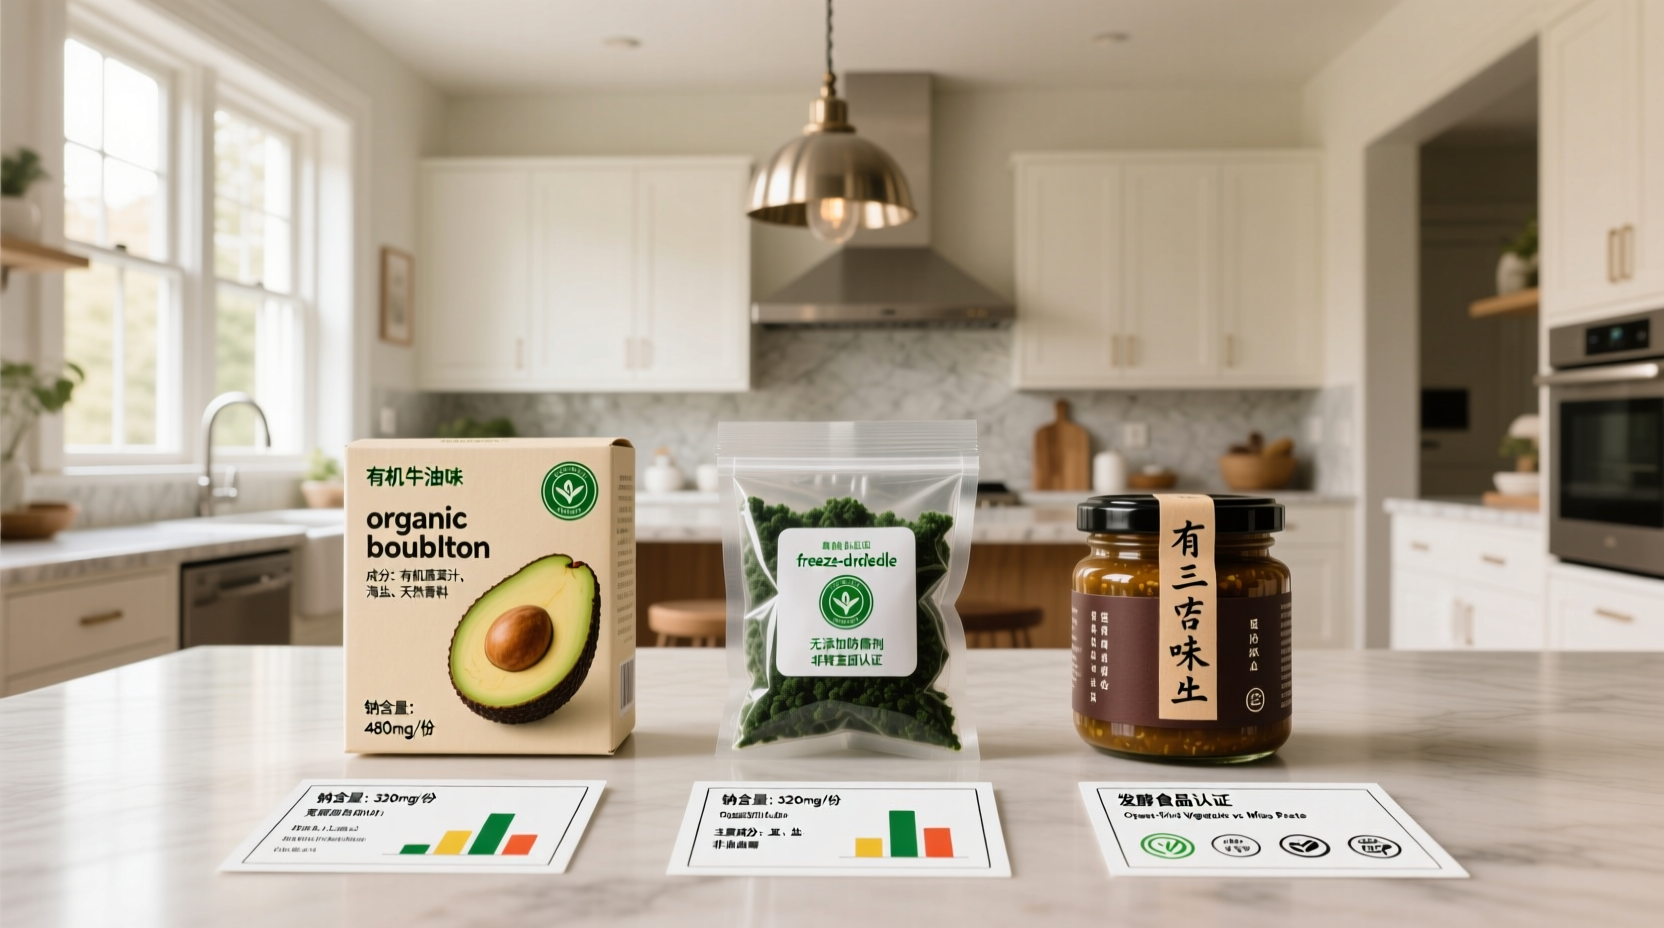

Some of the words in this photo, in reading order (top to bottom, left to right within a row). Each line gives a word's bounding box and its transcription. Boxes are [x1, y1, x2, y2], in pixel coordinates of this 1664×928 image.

[366, 465, 464, 487] 有机牛油味
[366, 505, 467, 536] organic
[367, 534, 490, 558] boublton
